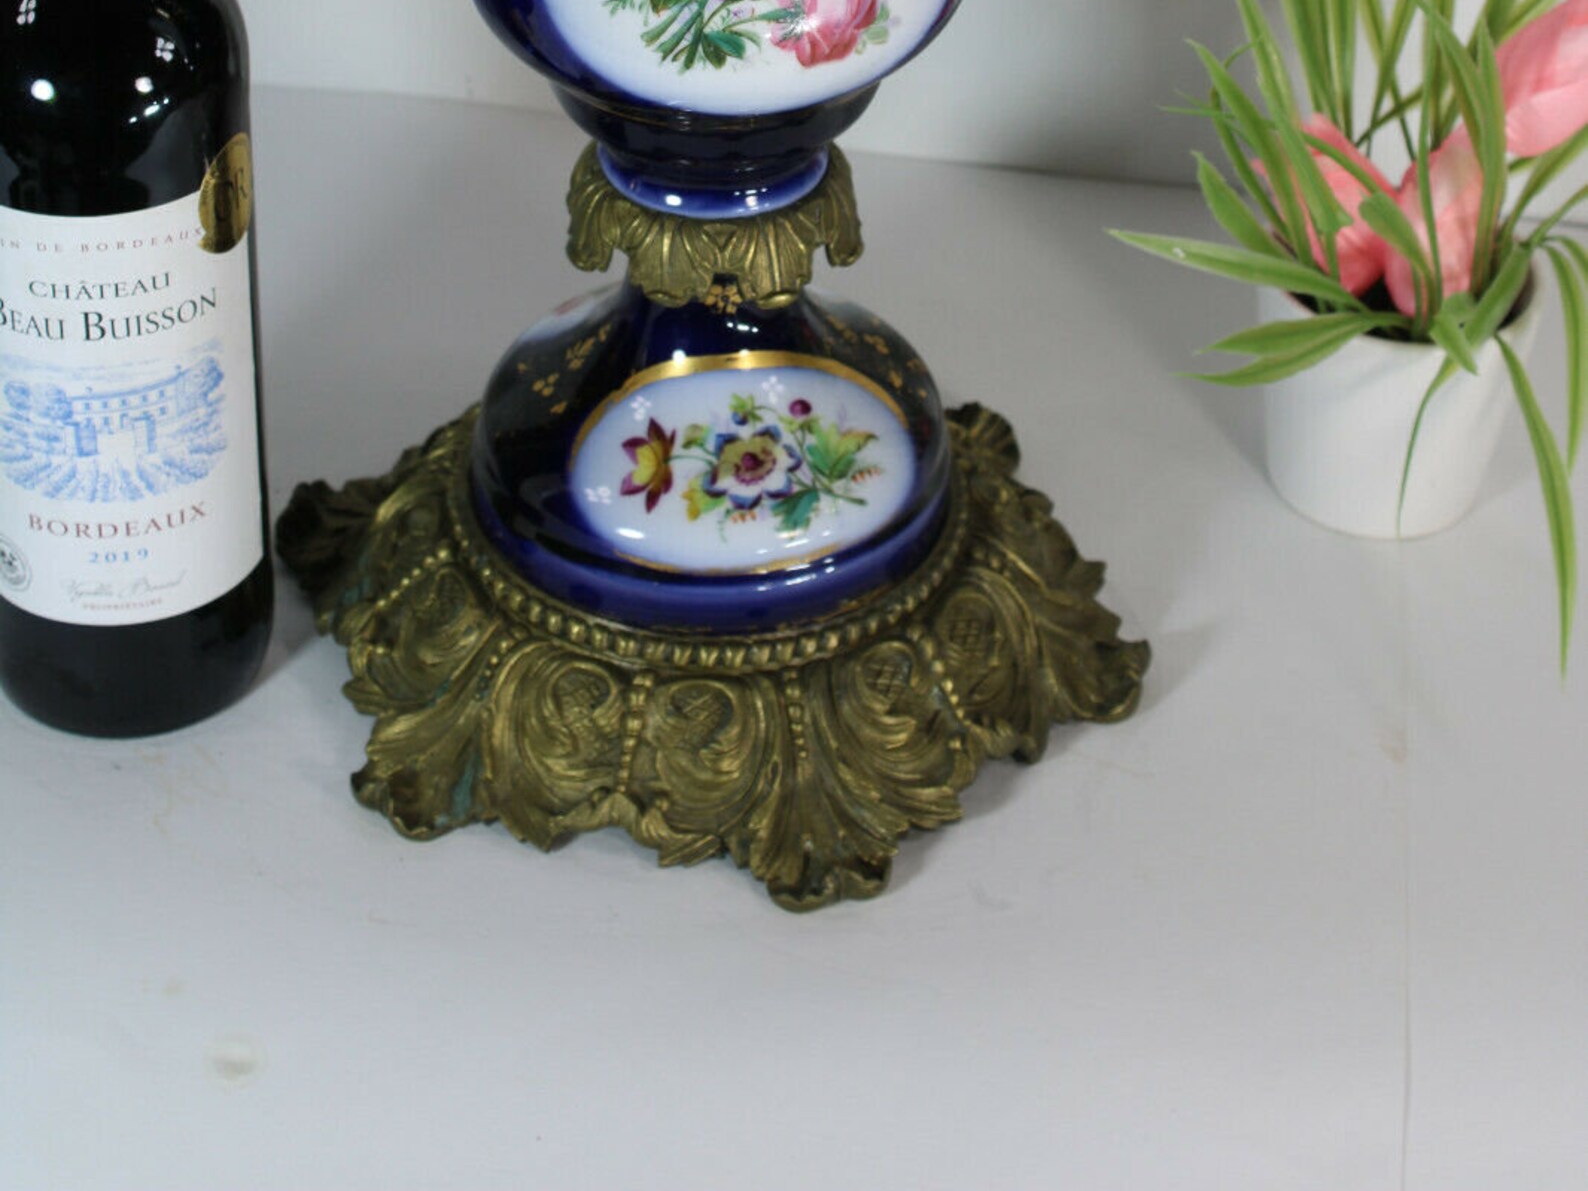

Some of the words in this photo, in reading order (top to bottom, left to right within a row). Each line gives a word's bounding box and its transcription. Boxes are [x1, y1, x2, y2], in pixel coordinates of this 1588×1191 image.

[0, 238, 20, 249] IN
[36, 242, 63, 252] DE
[28, 271, 170, 300] CHÂTEAU
[28, 501, 207, 539] BORDEAUX
[89, 547, 149, 563] 2019
